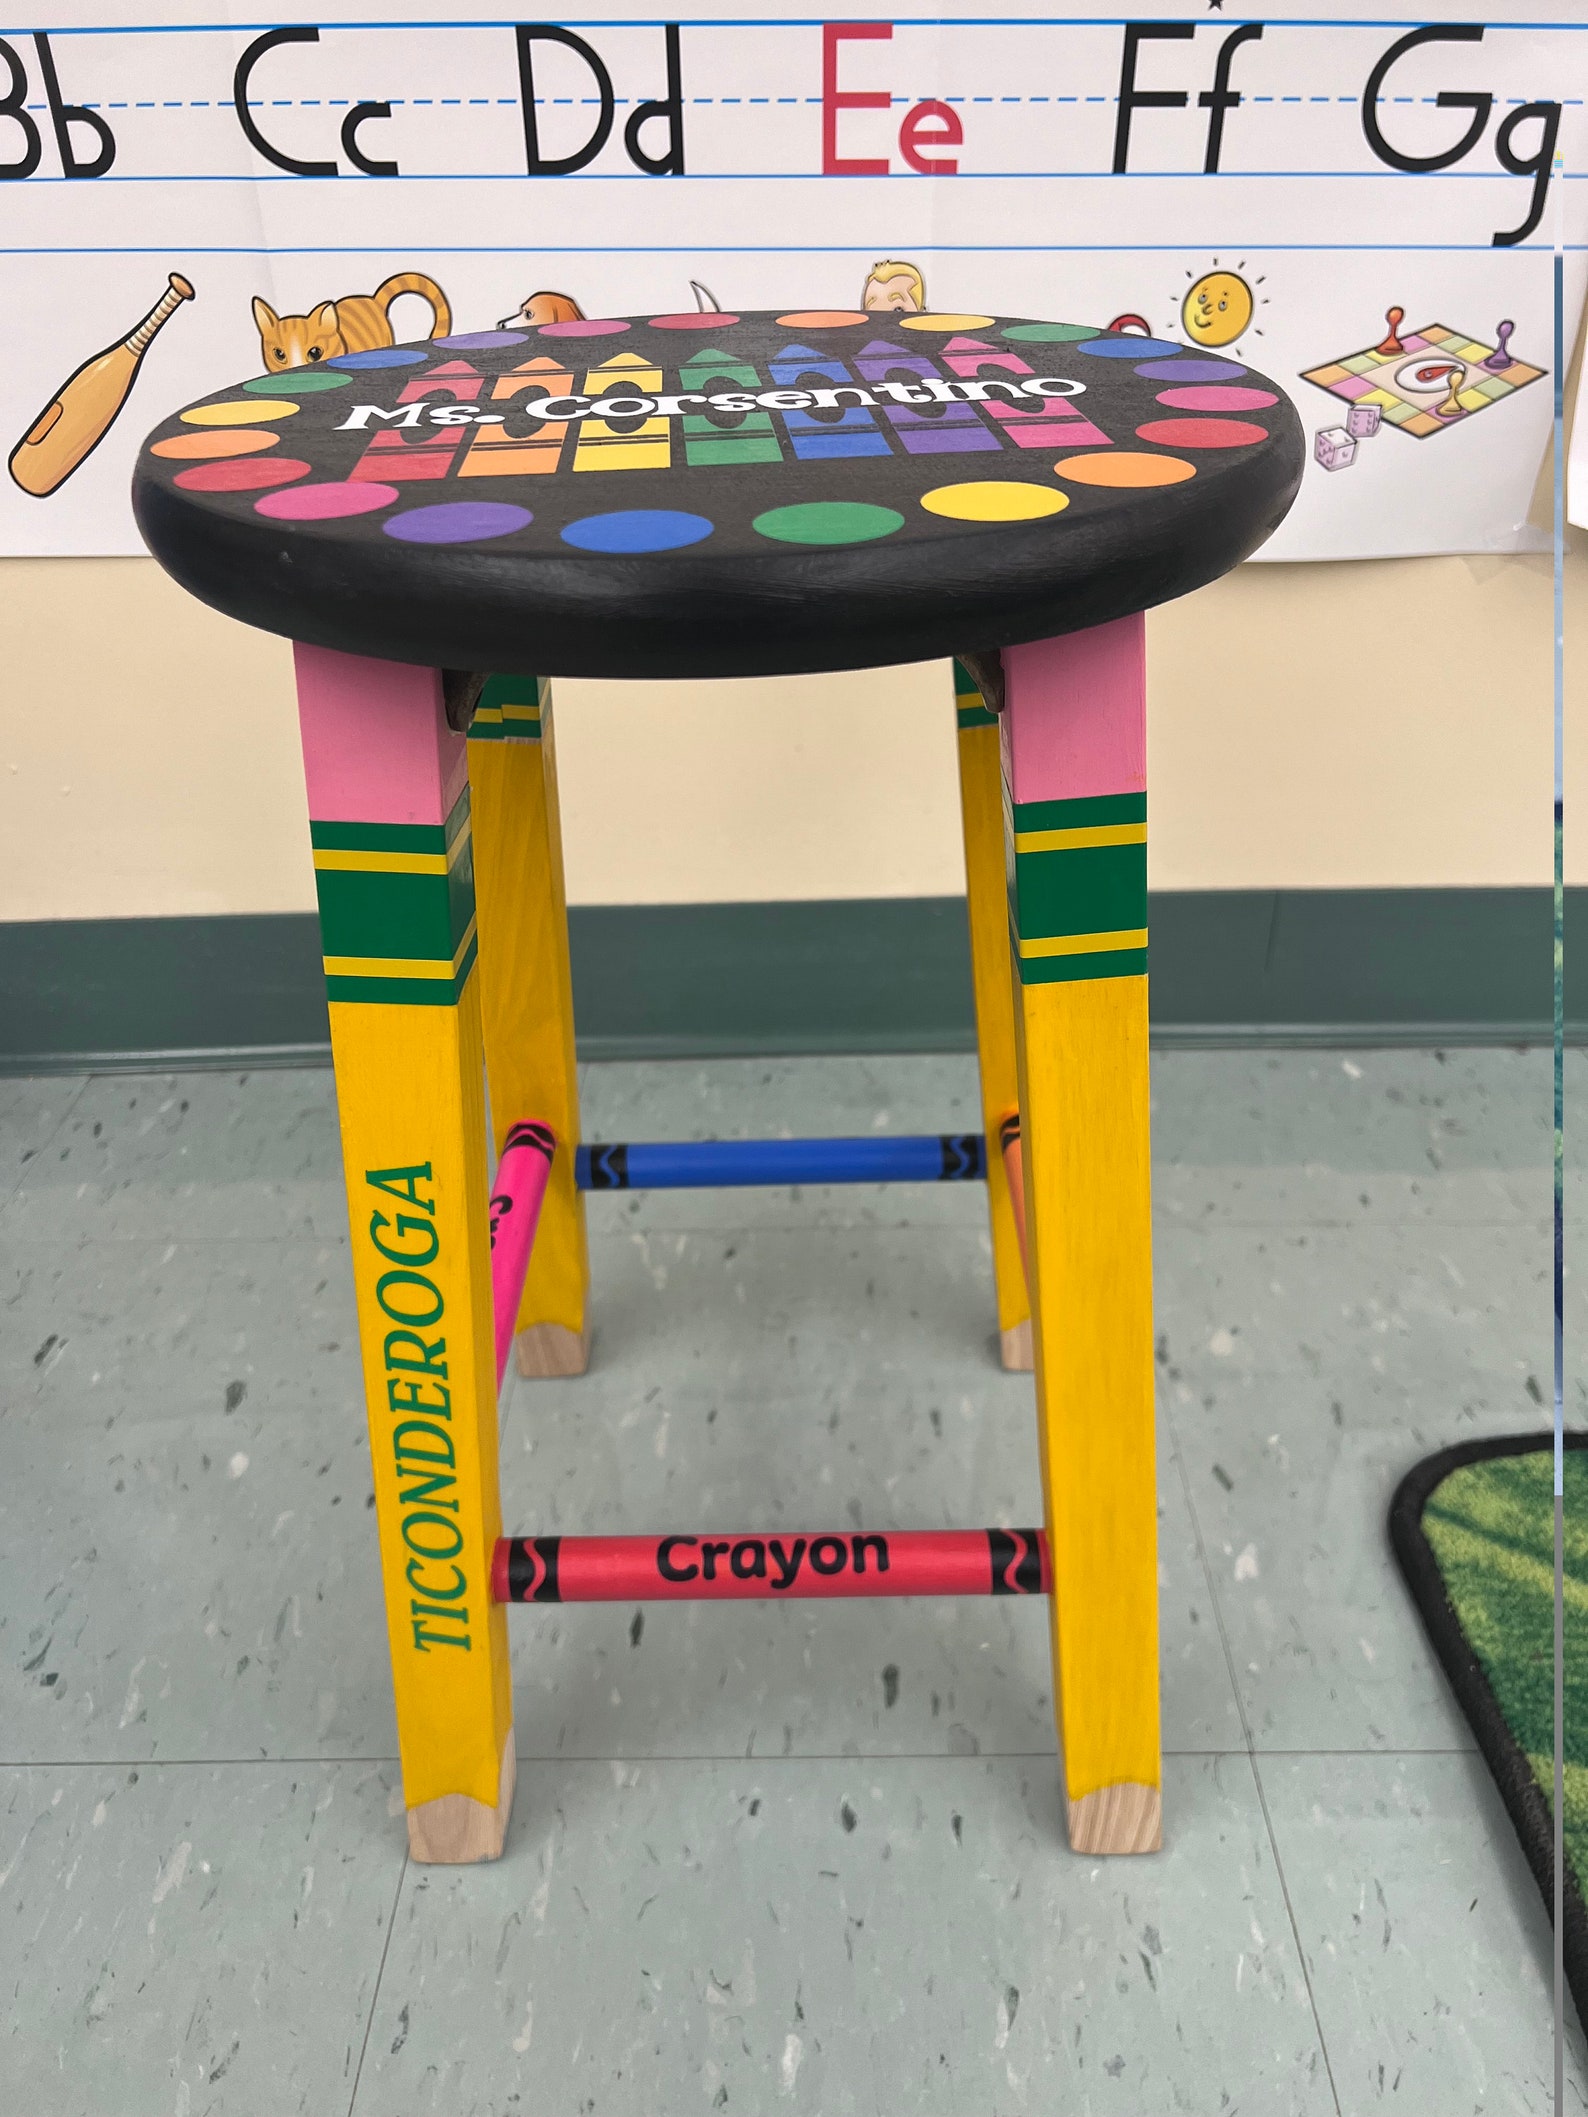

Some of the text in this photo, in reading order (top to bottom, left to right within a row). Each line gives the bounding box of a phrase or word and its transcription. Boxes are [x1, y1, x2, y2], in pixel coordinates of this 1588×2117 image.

[234, 27, 399, 176] Cc
[515, 24, 685, 176] Dd
[821, 23, 964, 175] Ee
[1111, 23, 1264, 174] Ff
[1361, 24, 1563, 248] Gg
[332, 377, 1087, 432] Ms. Corsentino
[365, 1160, 472, 1653] TICONDEROGA
[656, 1534, 890, 1589] Crayon
